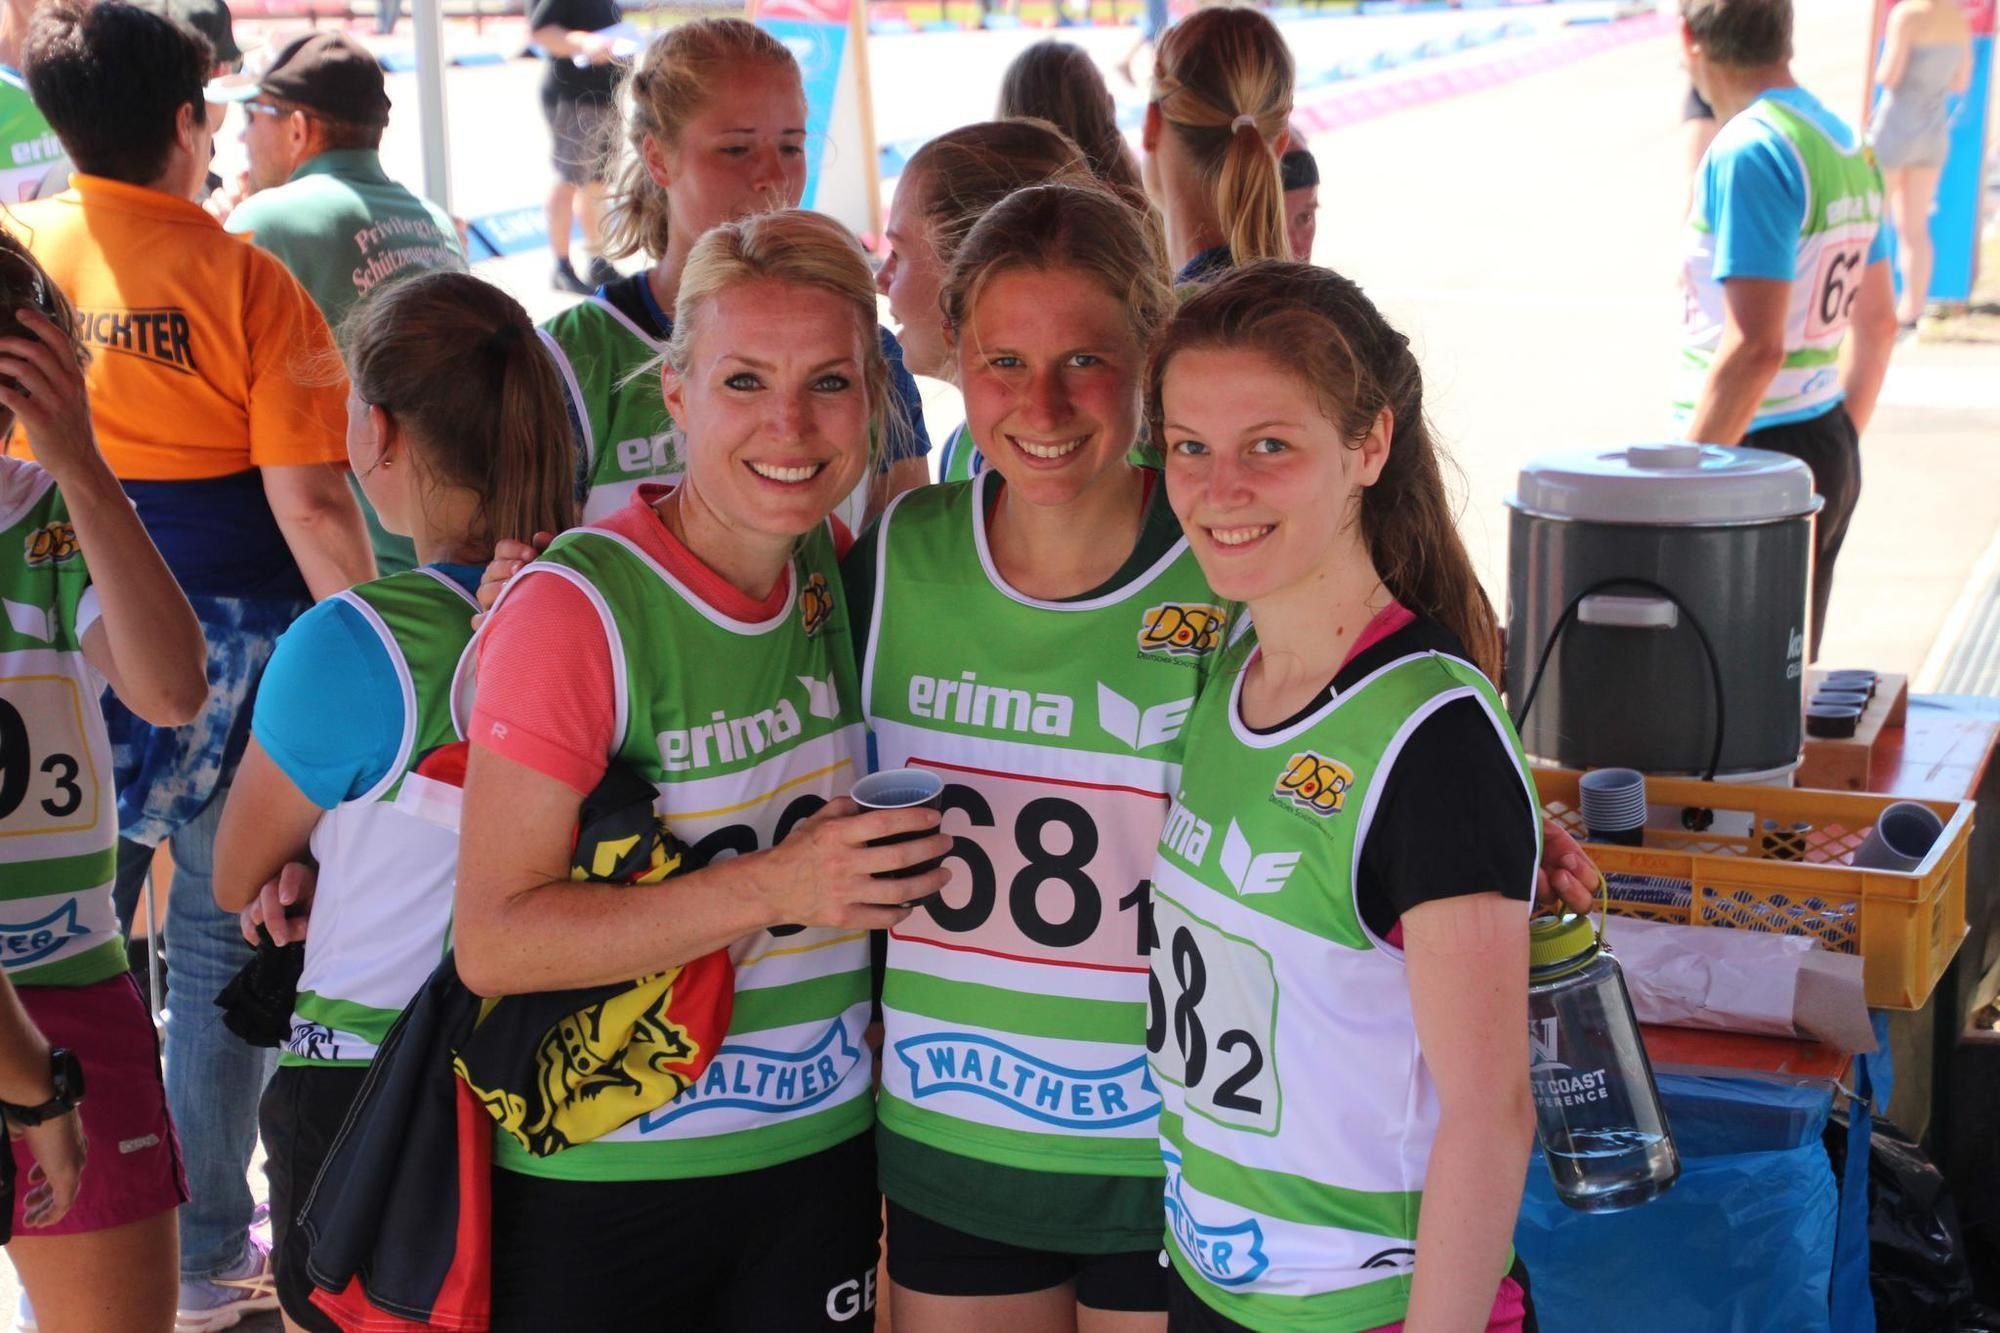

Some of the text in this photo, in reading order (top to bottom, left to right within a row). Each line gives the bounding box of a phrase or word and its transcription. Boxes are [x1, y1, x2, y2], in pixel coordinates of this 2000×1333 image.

[11, 131, 60, 165] eri
[617, 423, 687, 472] eri
[1143, 606, 1219, 650] DSB
[656, 698, 801, 772] erima
[908, 671, 1074, 737] erima
[40, 753, 82, 817] 3
[1281, 753, 1346, 810] DSB
[1160, 791, 1213, 867] ima
[920, 783, 1102, 948] 68
[926, 1047, 1129, 1115] WALTHER
[1212, 1029, 1264, 1115] 2
[1537, 1087, 1608, 1108] FERENCE
[1548, 1068, 1606, 1095] COAST
